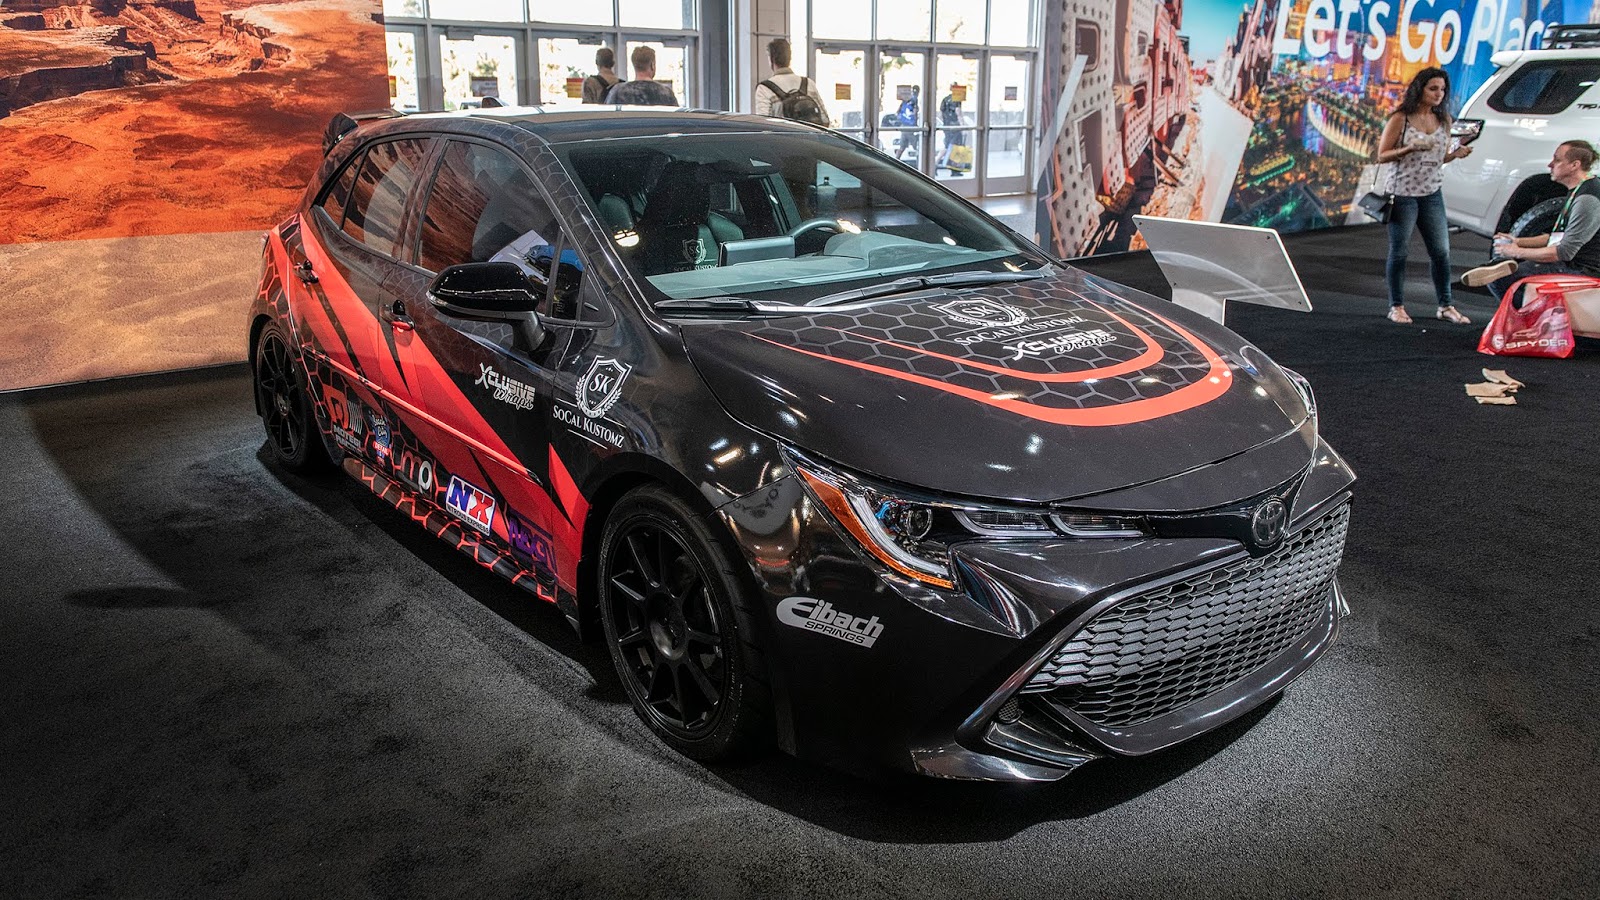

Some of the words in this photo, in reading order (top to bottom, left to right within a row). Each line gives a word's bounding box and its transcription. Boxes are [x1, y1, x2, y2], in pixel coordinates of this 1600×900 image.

[1273, 0, 1391, 61] Let's
[1400, 0, 1462, 65] Go
[961, 305, 1001, 318] SK
[1505, 339, 1568, 349] SPYDER
[588, 373, 615, 395] SK
[583, 418, 624, 448] KUSTOMZ
[449, 480, 494, 524] NX
[776, 596, 884, 638] Eibach
[805, 620, 865, 644] SPRINGS
